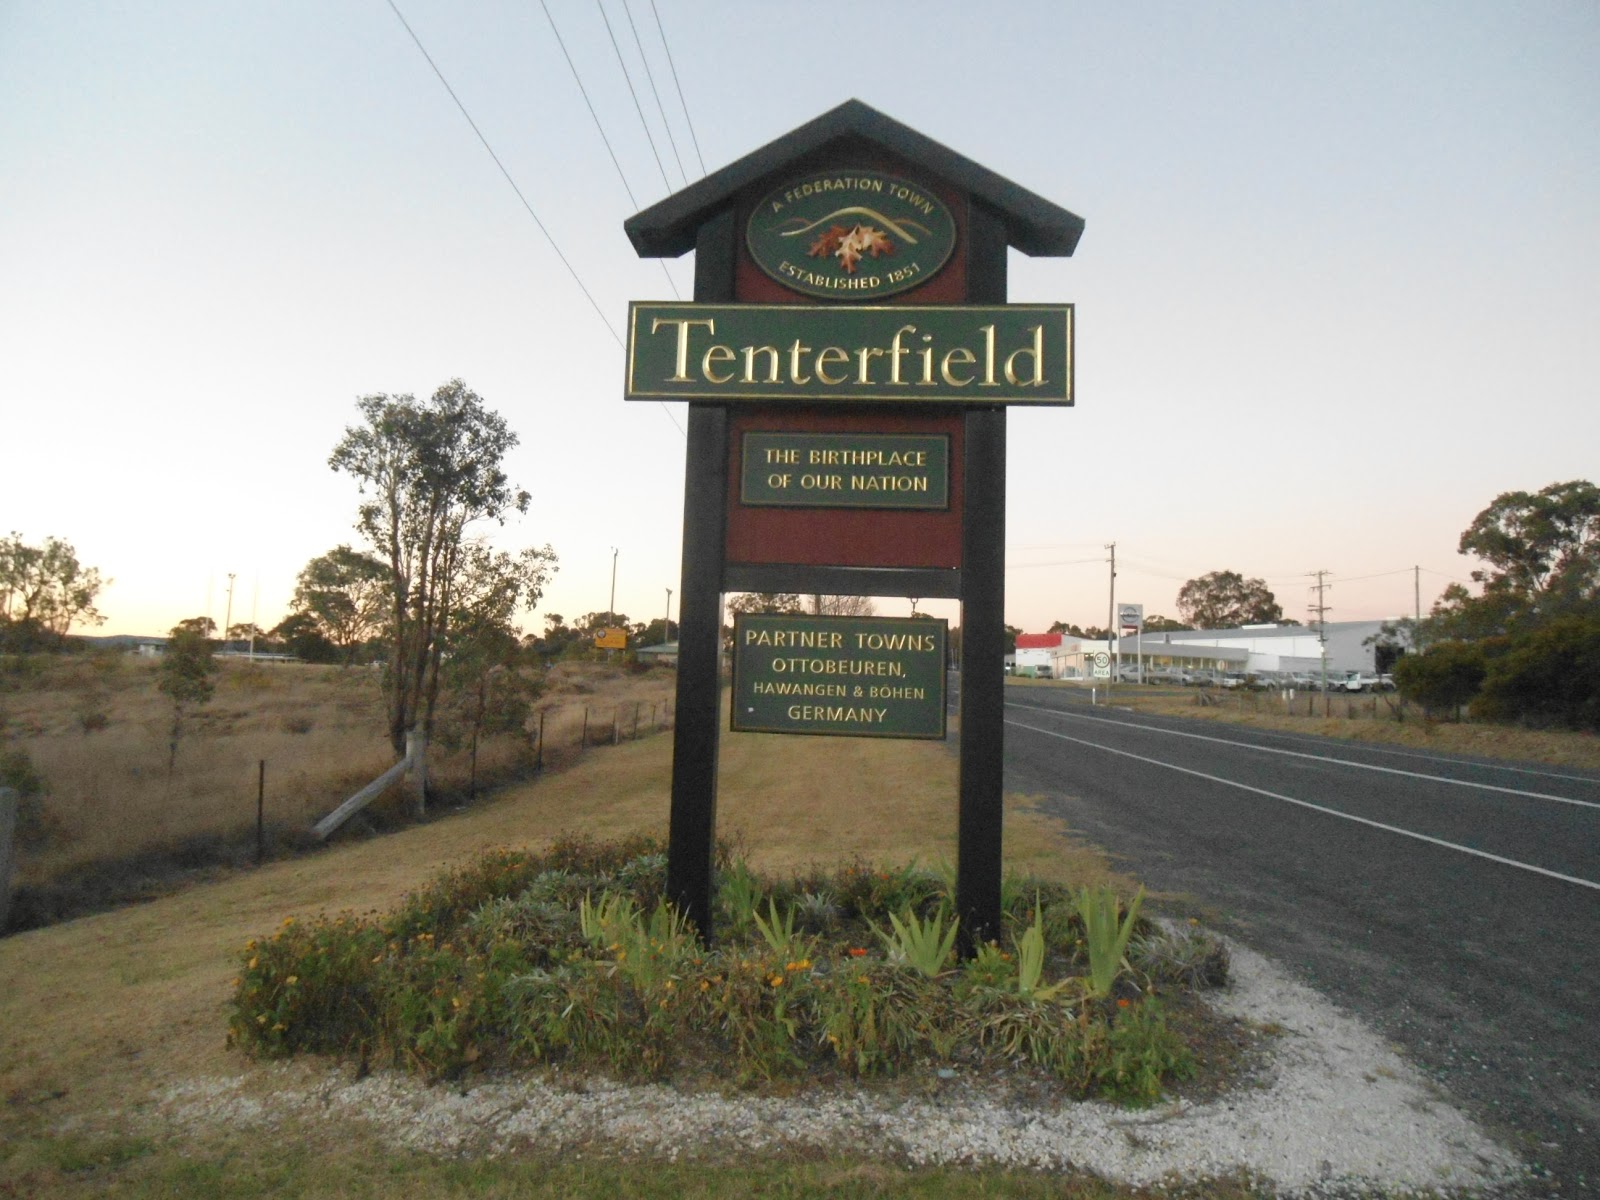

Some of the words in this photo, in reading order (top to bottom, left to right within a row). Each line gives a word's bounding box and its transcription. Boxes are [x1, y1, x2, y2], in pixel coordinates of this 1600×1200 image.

[772, 202, 782, 213] A
[785, 178, 883, 201] FEDERATION
[890, 183, 934, 214] TOWN
[778, 260, 880, 290] ESTABLISHED
[887, 262, 921, 284] 1851
[651, 317, 1049, 388] Tenterfield
[764, 448, 800, 464] THE
[809, 450, 926, 467] BIRTHPLACE
[767, 473, 792, 489] OF
[800, 474, 842, 490] OUR
[851, 475, 927, 492] NATION
[745, 630, 843, 649] PARTNER
[855, 633, 935, 652] TOWNS
[772, 657, 906, 679] OTTOBEUREN,
[1096, 656, 1108, 664] 50
[753, 681, 847, 697] HAWANGEN
[853, 685, 864, 698] &
[787, 705, 888, 723] GERMANY
